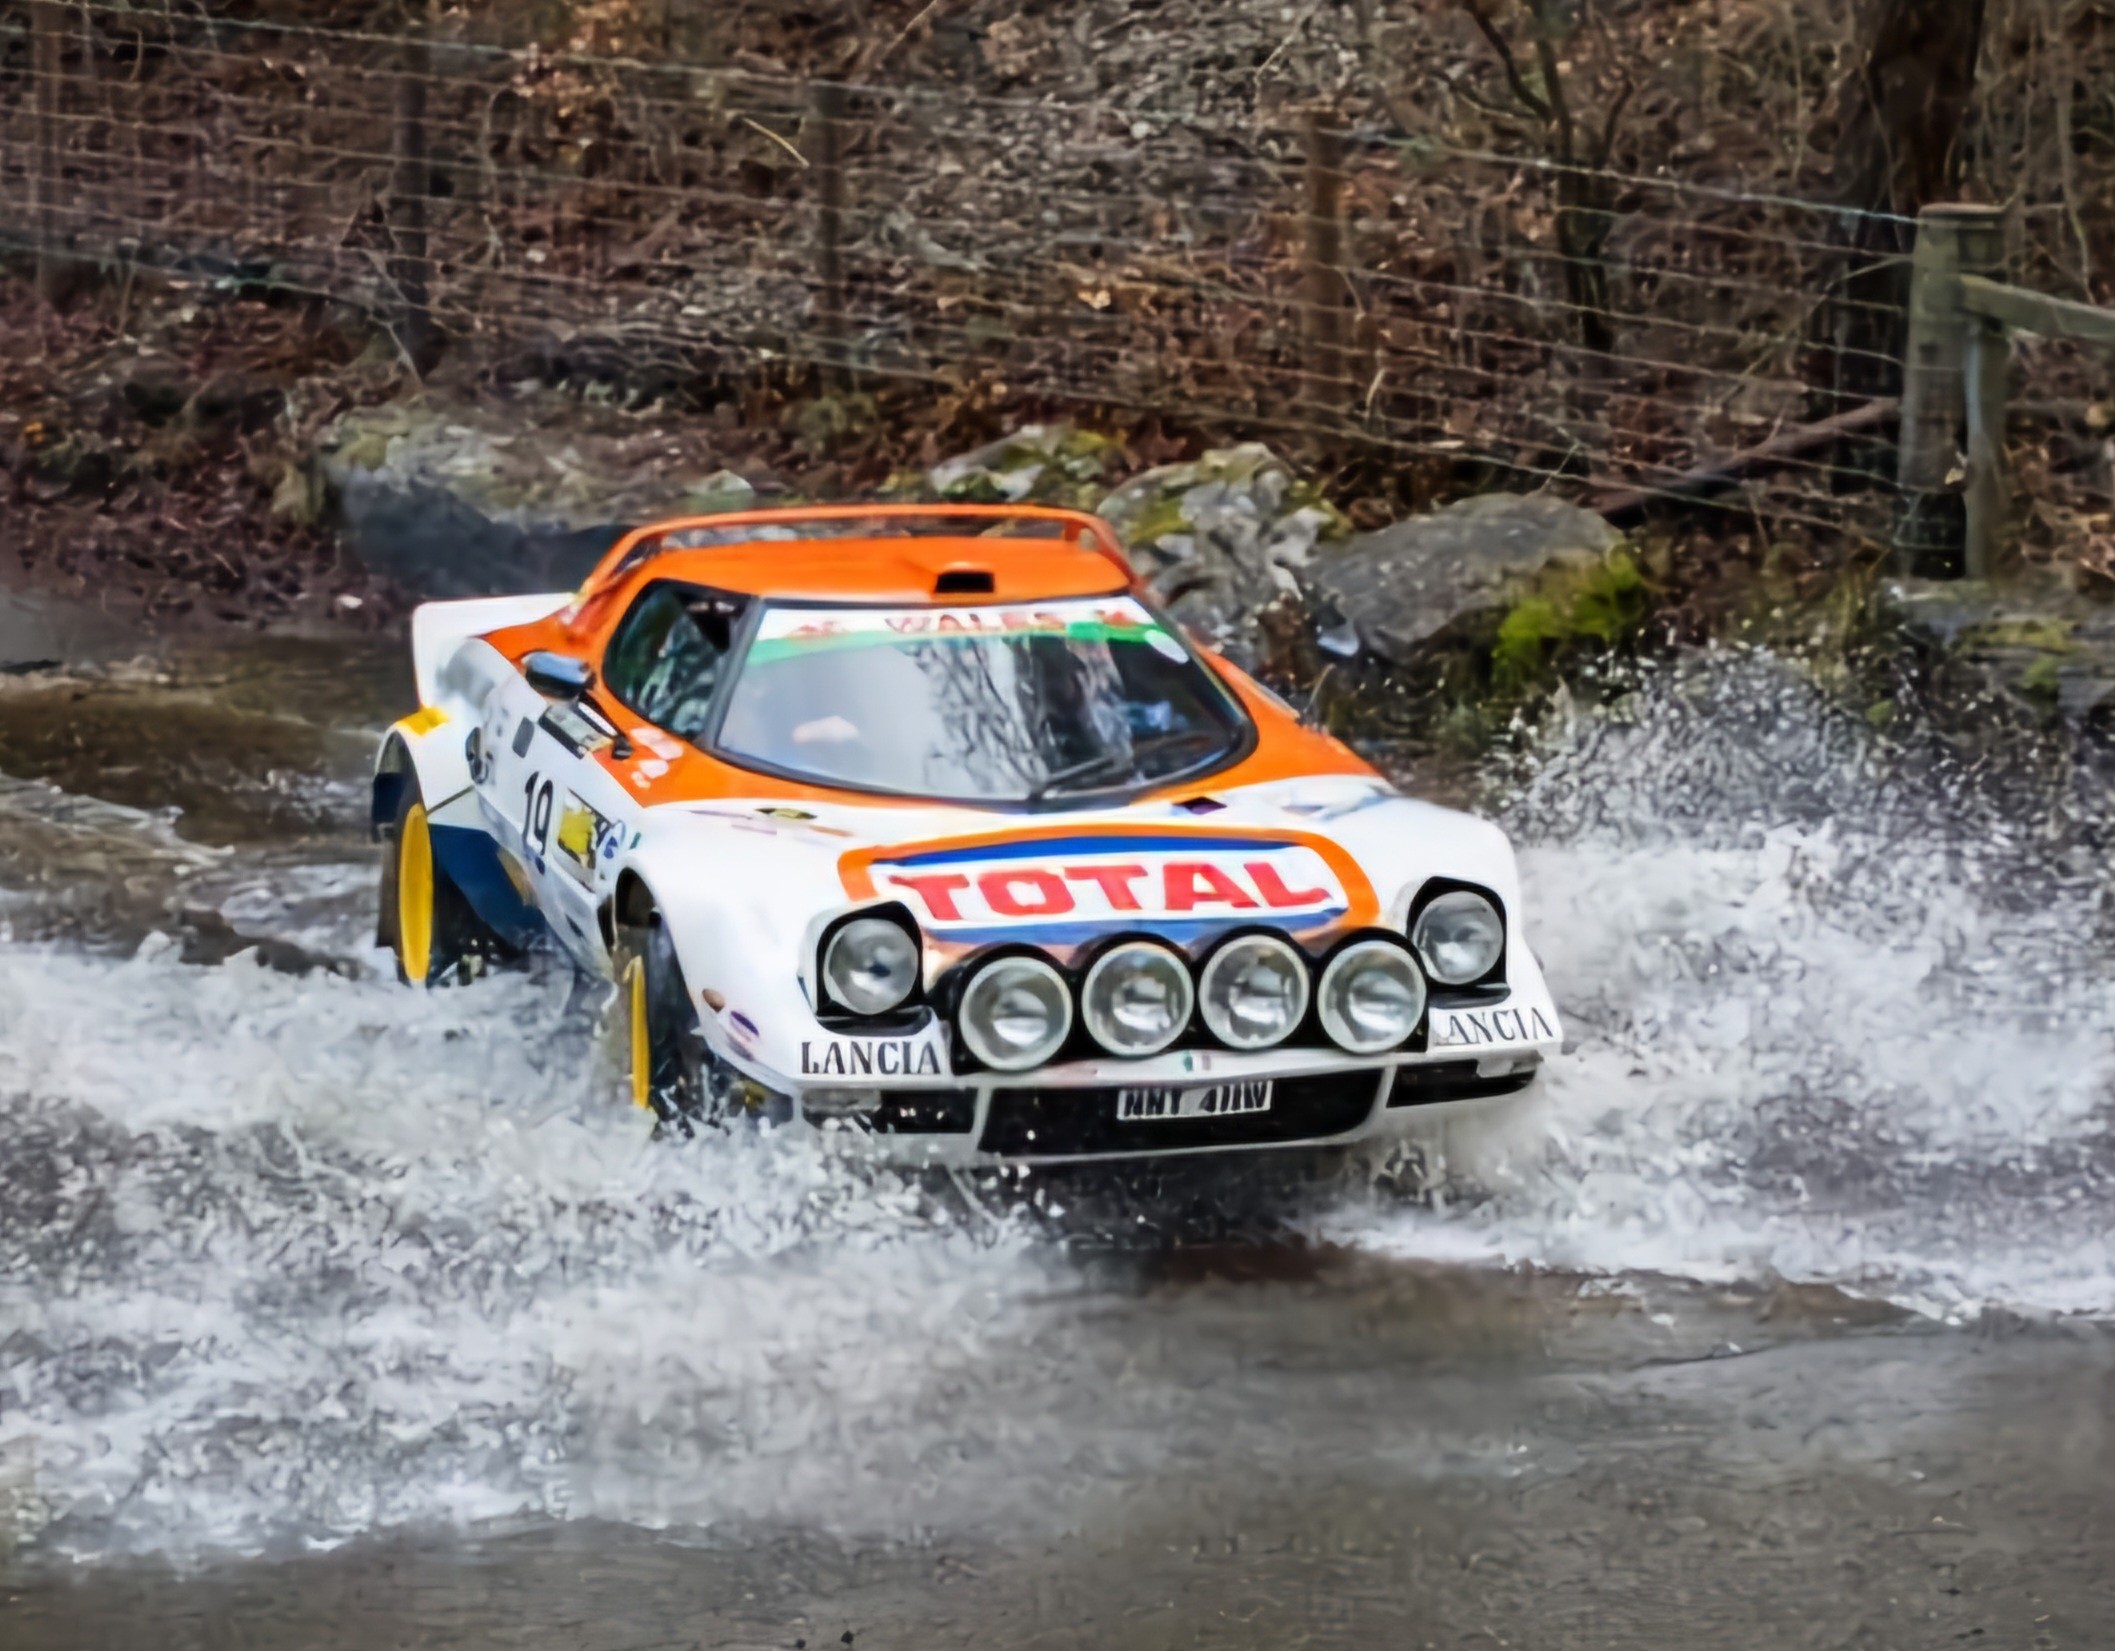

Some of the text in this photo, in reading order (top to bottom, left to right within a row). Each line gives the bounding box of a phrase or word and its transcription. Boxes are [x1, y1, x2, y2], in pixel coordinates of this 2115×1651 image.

[522, 771, 554, 856] 19
[890, 862, 1332, 921] TOTAL
[802, 1041, 941, 1075] LANCIA
